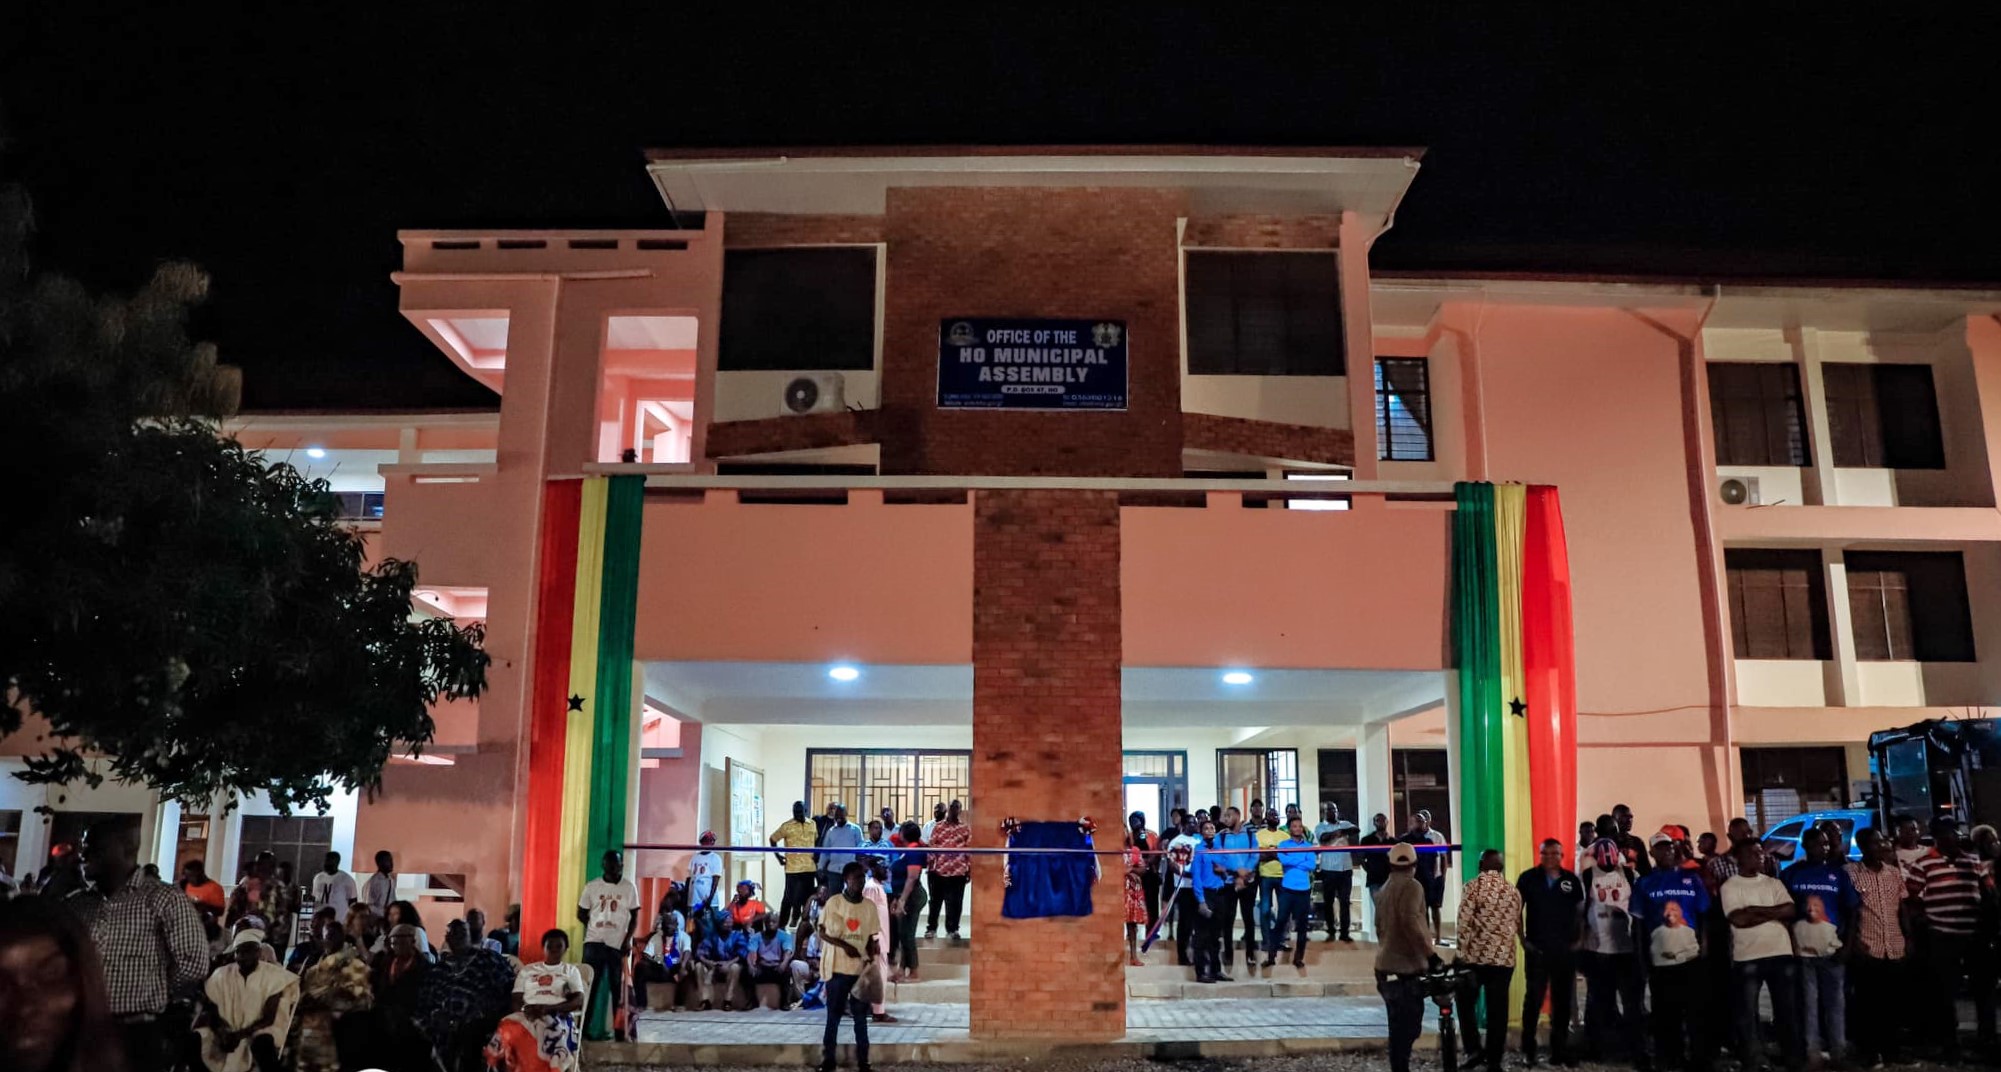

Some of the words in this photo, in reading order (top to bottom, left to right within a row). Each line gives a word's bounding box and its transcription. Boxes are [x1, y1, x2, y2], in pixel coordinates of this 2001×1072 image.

[986, 329, 1031, 344] OFFICE
[1034, 329, 1050, 344] OF
[1054, 330, 1077, 344] THE
[959, 347, 986, 363] HO
[993, 348, 1108, 364] MUNICIPAL
[978, 366, 1089, 383] ASSEMBLY
